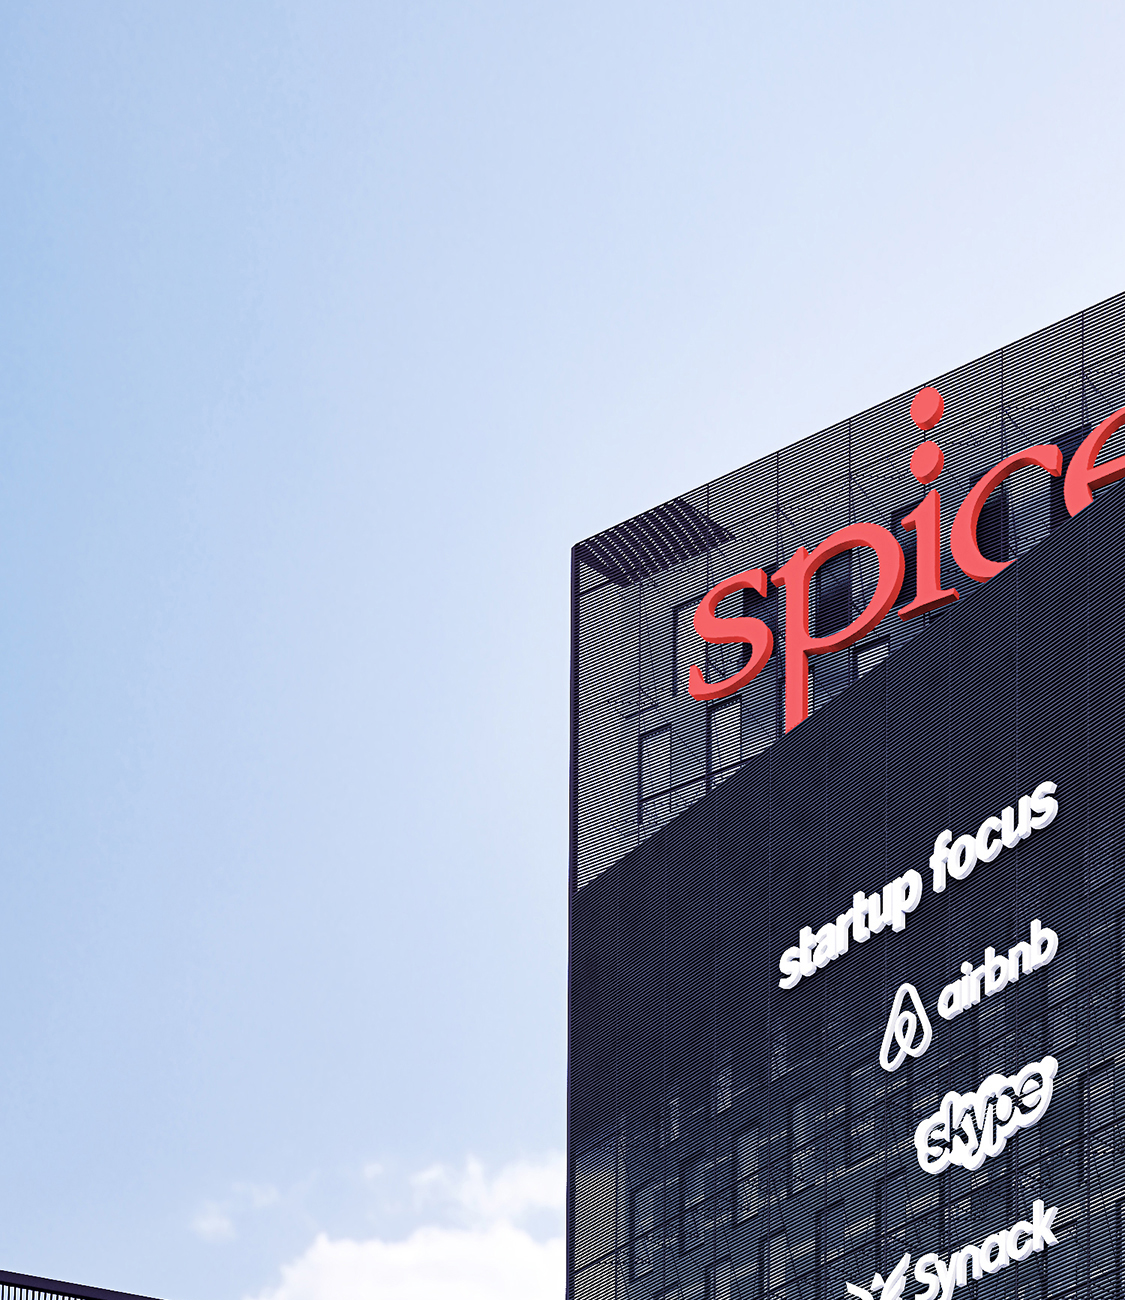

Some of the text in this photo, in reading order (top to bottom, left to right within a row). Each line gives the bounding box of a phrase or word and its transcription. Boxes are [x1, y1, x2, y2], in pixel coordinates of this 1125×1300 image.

[779, 780, 1058, 989] startup focus
[937, 918, 1059, 1020] airbnb
[914, 1055, 1059, 1174] skype
